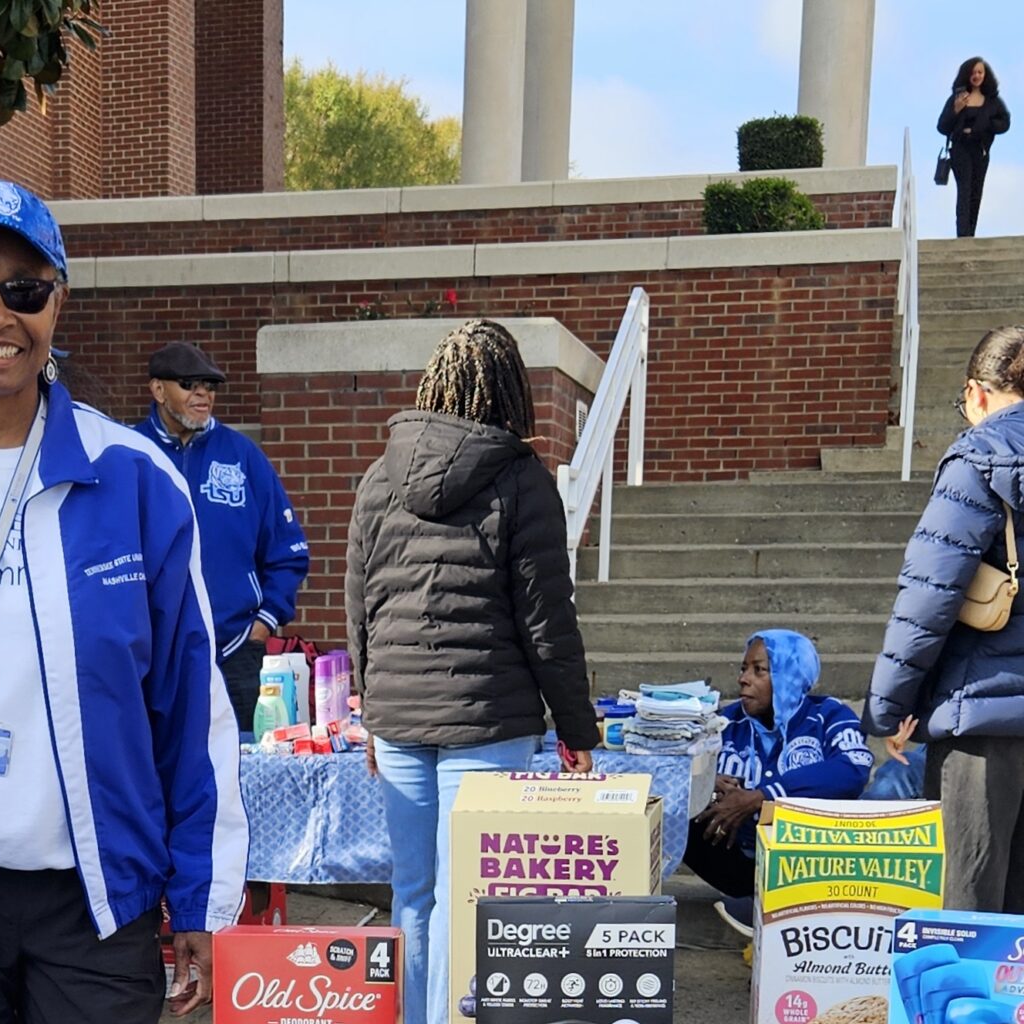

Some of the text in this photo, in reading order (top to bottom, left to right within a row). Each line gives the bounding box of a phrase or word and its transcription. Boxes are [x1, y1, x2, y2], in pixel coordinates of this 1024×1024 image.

[102, 573, 137, 585] NASHVILLE
[537, 795, 581, 803] Raspberry
[780, 822, 931, 845] NATURE VALLEY
[480, 858, 619, 881] BAKERY
[777, 856, 933, 889] NATURE VALLEY
[827, 885, 879, 898] 30 COUNT
[487, 919, 571, 946] Degree
[602, 930, 666, 943] 5 PACK
[897, 922, 918, 943] 4
[956, 930, 977, 939] SOLID
[370, 942, 390, 968] 4
[609, 949, 668, 958] PROTECTION
[370, 968, 390, 978] PACK
[793, 960, 852, 975] Almond
[232, 972, 377, 1017] Old Spice
